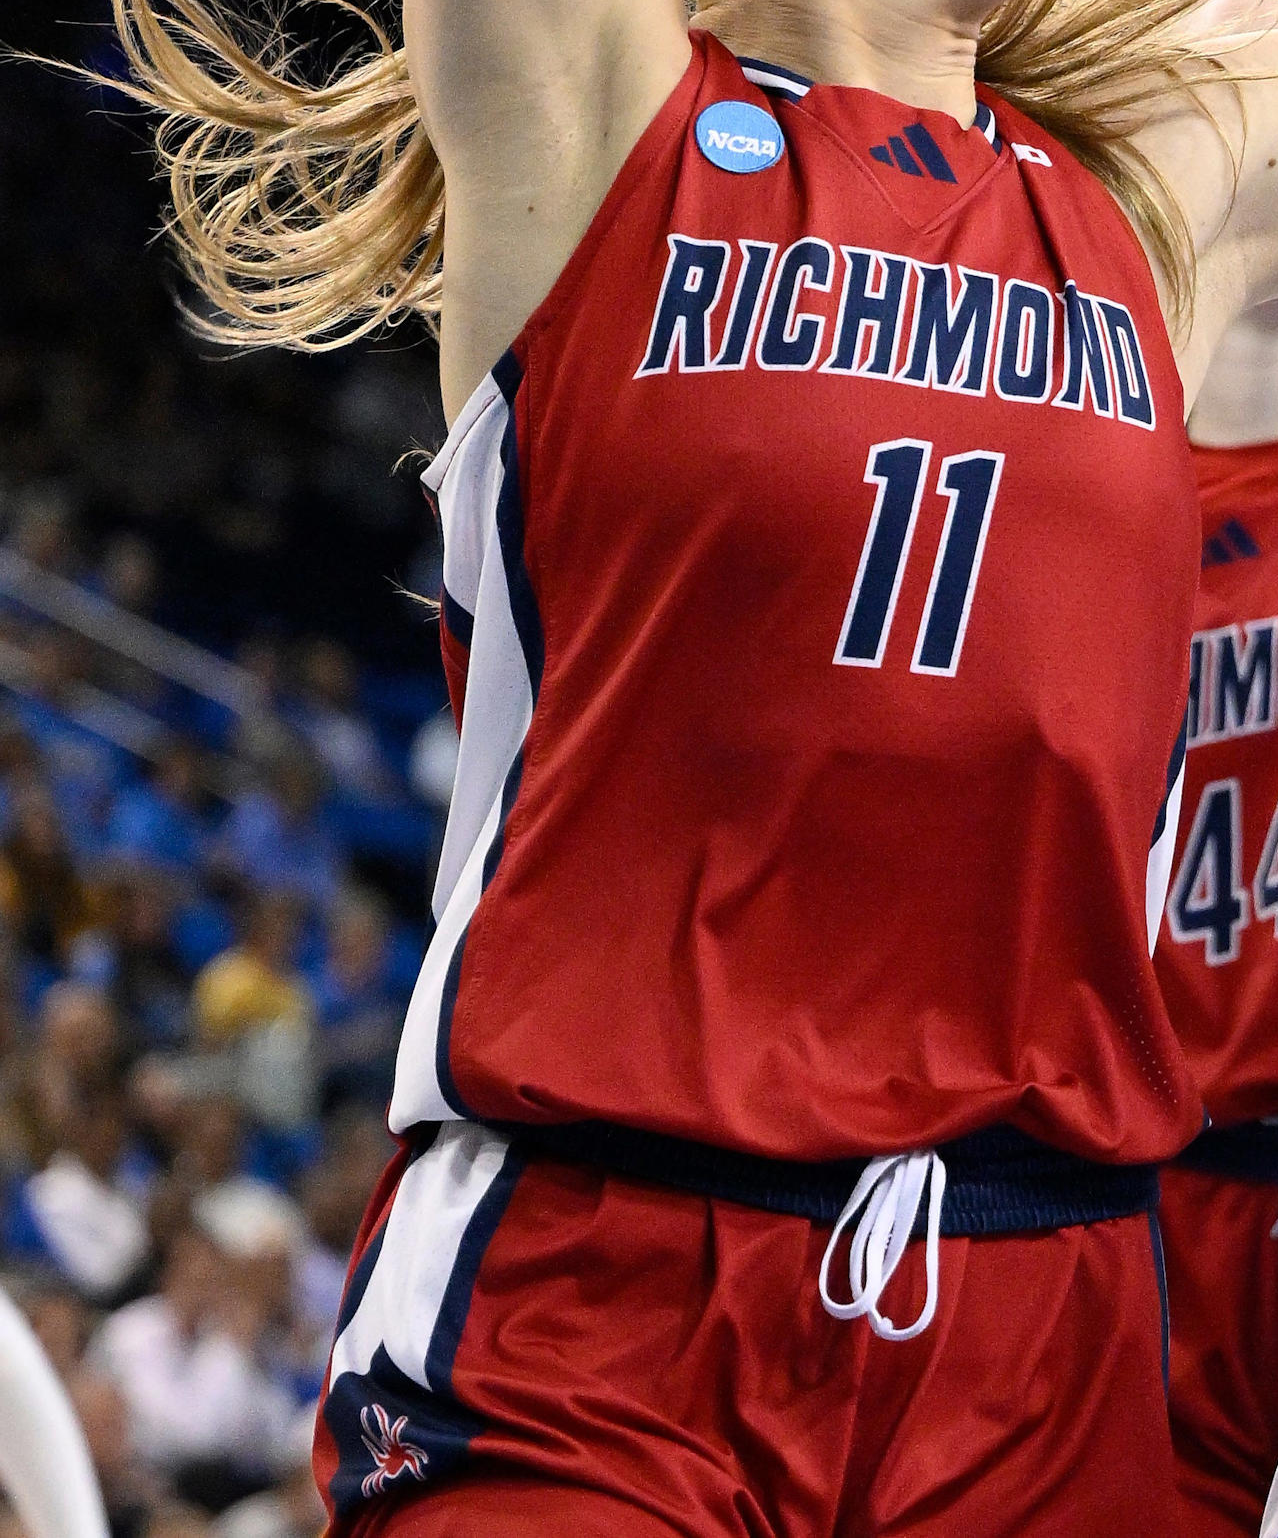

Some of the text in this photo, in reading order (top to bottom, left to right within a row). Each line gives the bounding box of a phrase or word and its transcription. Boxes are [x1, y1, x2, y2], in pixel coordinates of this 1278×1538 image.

[706, 129, 776, 158] NCAA
[633, 233, 1156, 431] RICHMOND
[832, 437, 1006, 679] 11
